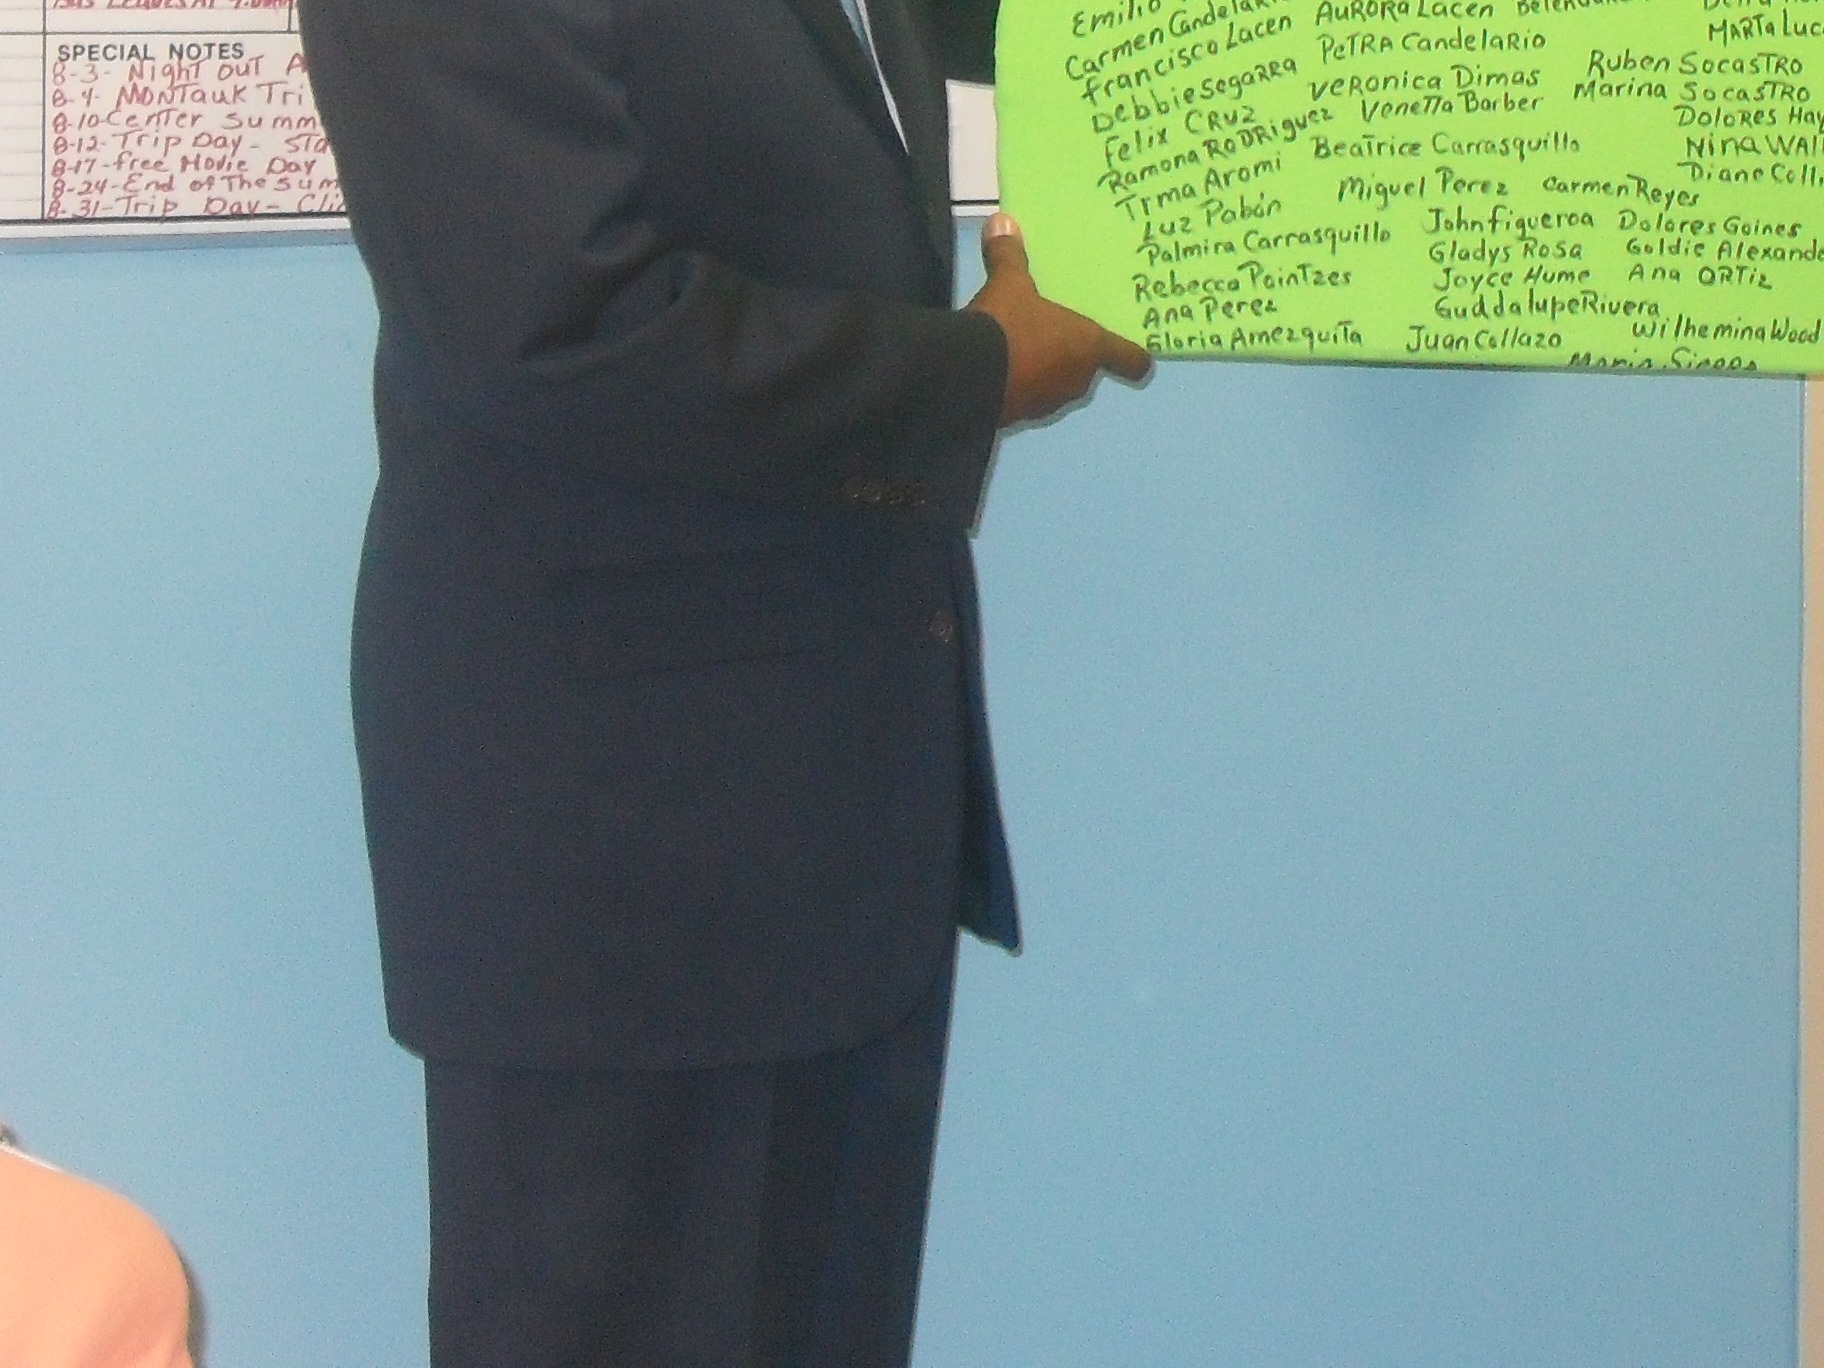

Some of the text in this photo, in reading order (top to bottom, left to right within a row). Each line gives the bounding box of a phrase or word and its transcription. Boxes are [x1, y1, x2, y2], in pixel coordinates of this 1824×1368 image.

[1225, 14, 1293, 51] Lacen
[57, 42, 245, 62] SPECIAL NOTES
[1064, 27, 1165, 83] Carmen
[1586, 48, 1671, 78] Ruben
[1449, 64, 1542, 90] Dimas
[1336, 164, 1510, 211] Miguel Perez
[1432, 266, 1514, 294] Joyce
[1405, 323, 1470, 354] Juan
